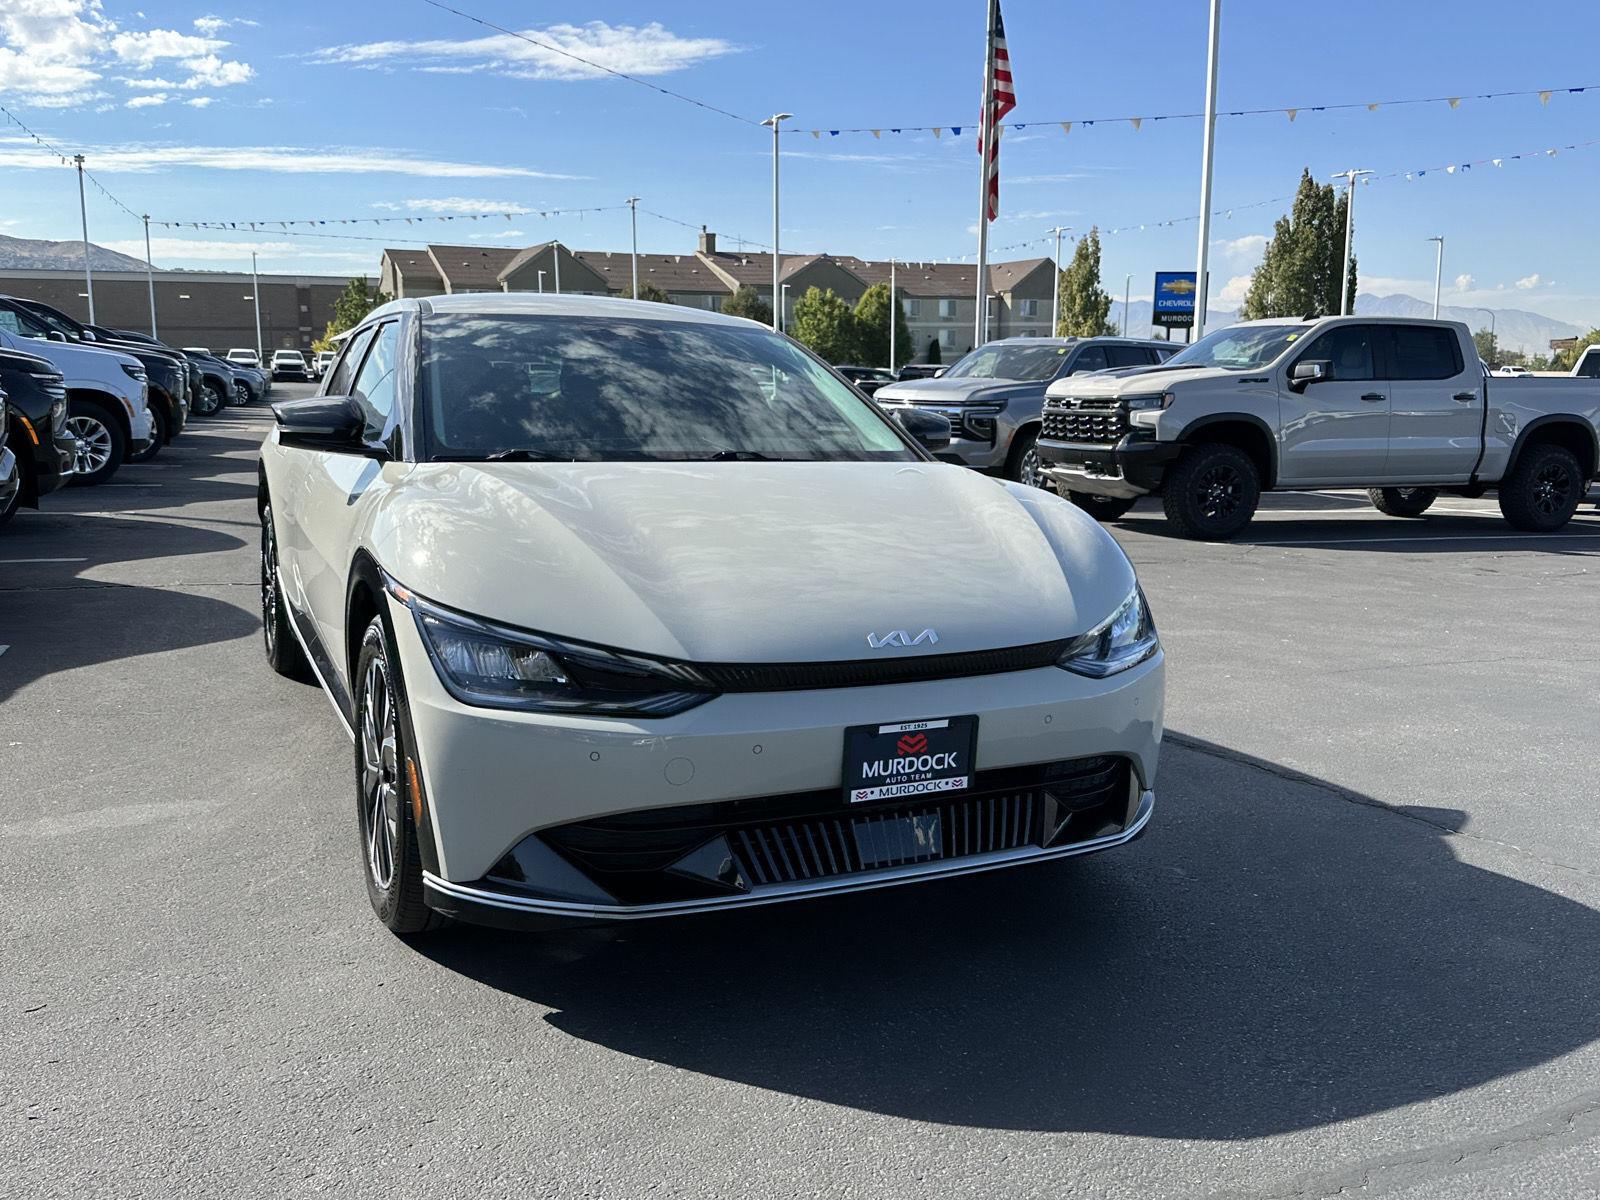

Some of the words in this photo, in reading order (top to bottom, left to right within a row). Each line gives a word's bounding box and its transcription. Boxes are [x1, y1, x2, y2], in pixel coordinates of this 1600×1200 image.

[1158, 299, 1195, 307] CHEVROL
[867, 628, 939, 648] KIA
[862, 752, 957, 778] MURDOCK
[885, 776, 907, 784] AUTO
[910, 773, 932, 781] TEAM
[878, 781, 942, 797] MURDOCK
